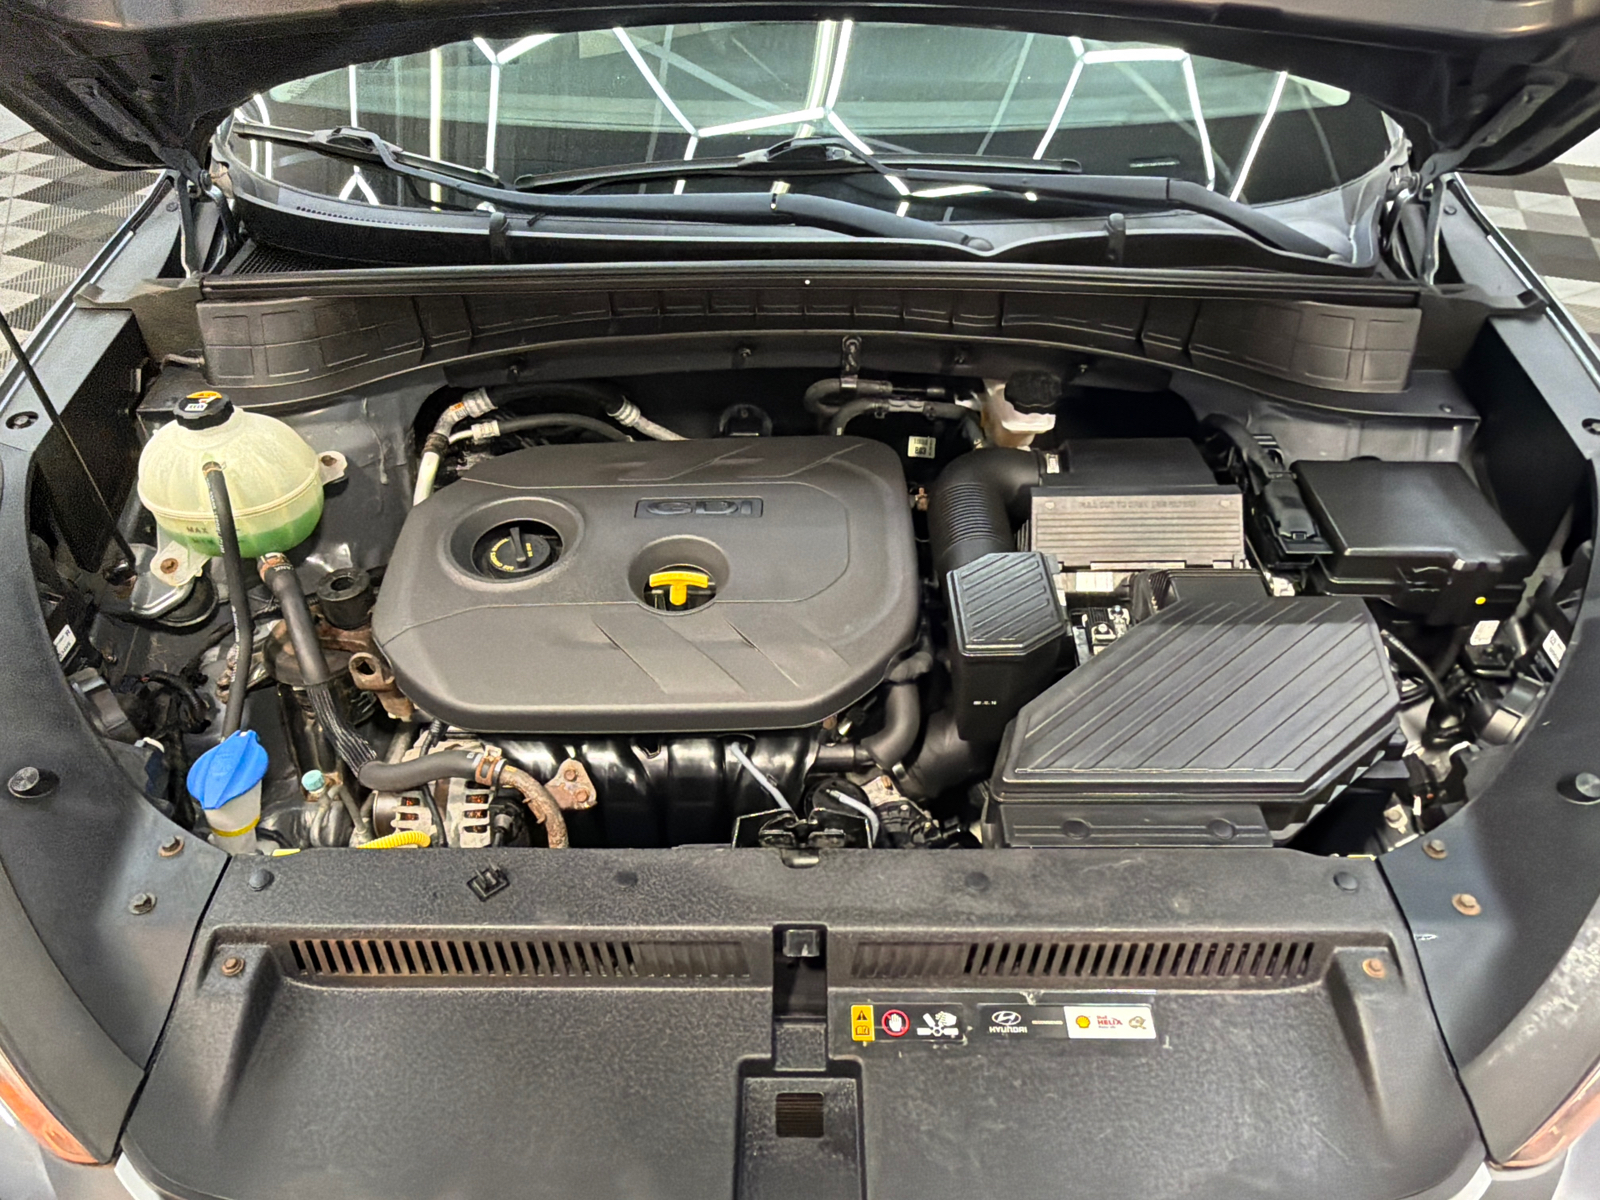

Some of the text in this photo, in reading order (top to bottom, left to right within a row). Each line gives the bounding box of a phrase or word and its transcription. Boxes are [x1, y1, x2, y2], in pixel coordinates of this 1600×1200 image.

[645, 500, 753, 515] GDI
[186, 526, 208, 534] MAX
[1097, 1018, 1123, 1026] HELIX
[988, 1026, 1028, 1034] HYUNDAI
